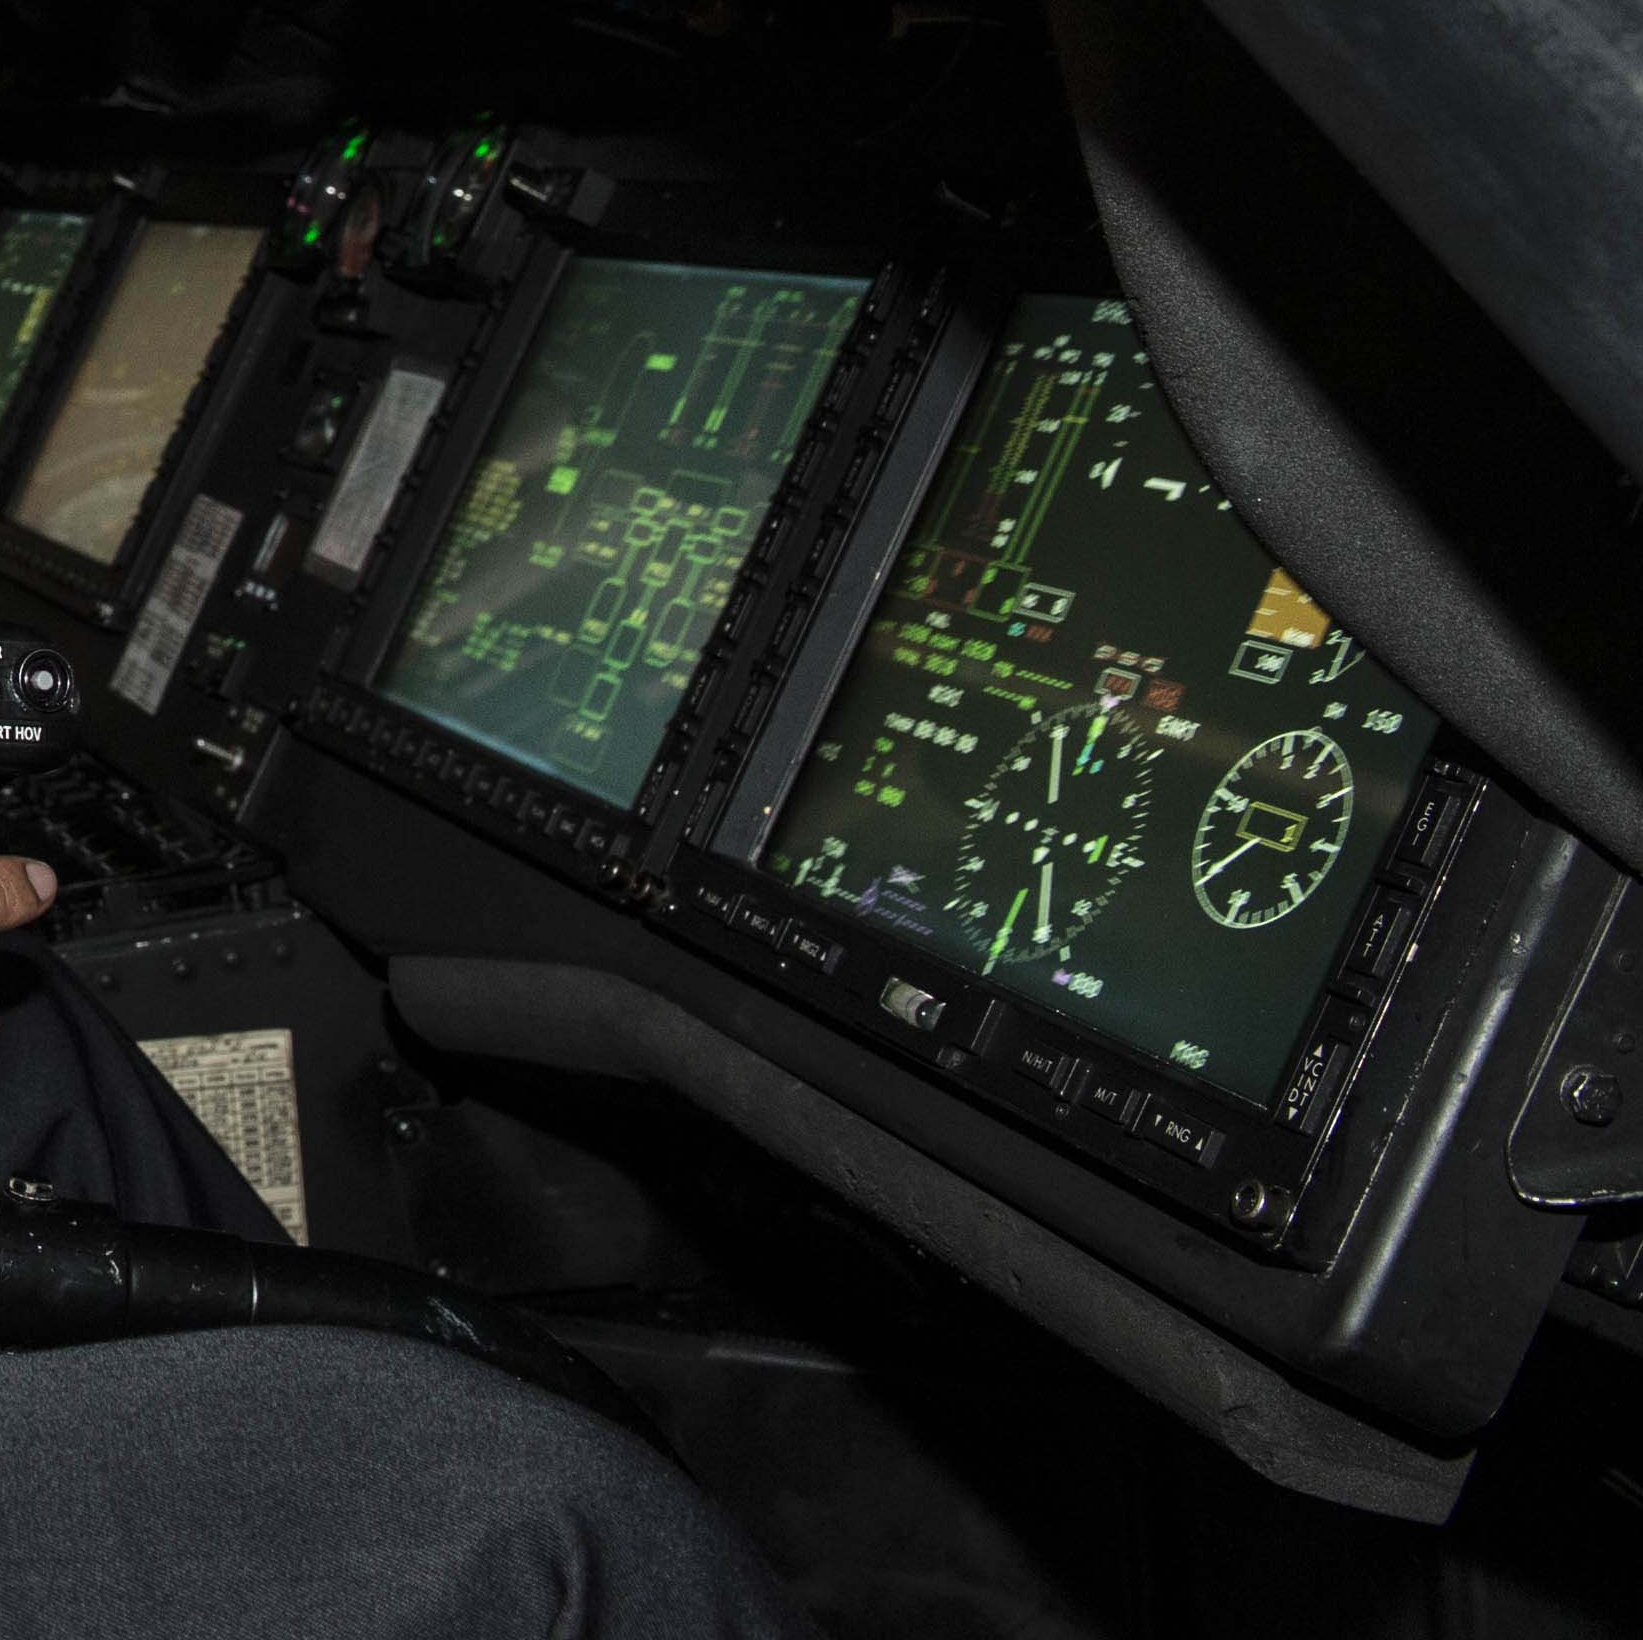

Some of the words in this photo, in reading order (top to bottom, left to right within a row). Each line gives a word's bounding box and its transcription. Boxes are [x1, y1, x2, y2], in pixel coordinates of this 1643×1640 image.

[14, 725, 42, 743] HOV
[1411, 801, 1436, 847] EGI
[1362, 913, 1386, 959] ATT
[1021, 1048, 1053, 1075] N/H/T
[1093, 1086, 1119, 1108] M/T
[1164, 1120, 1191, 1144] RNG
